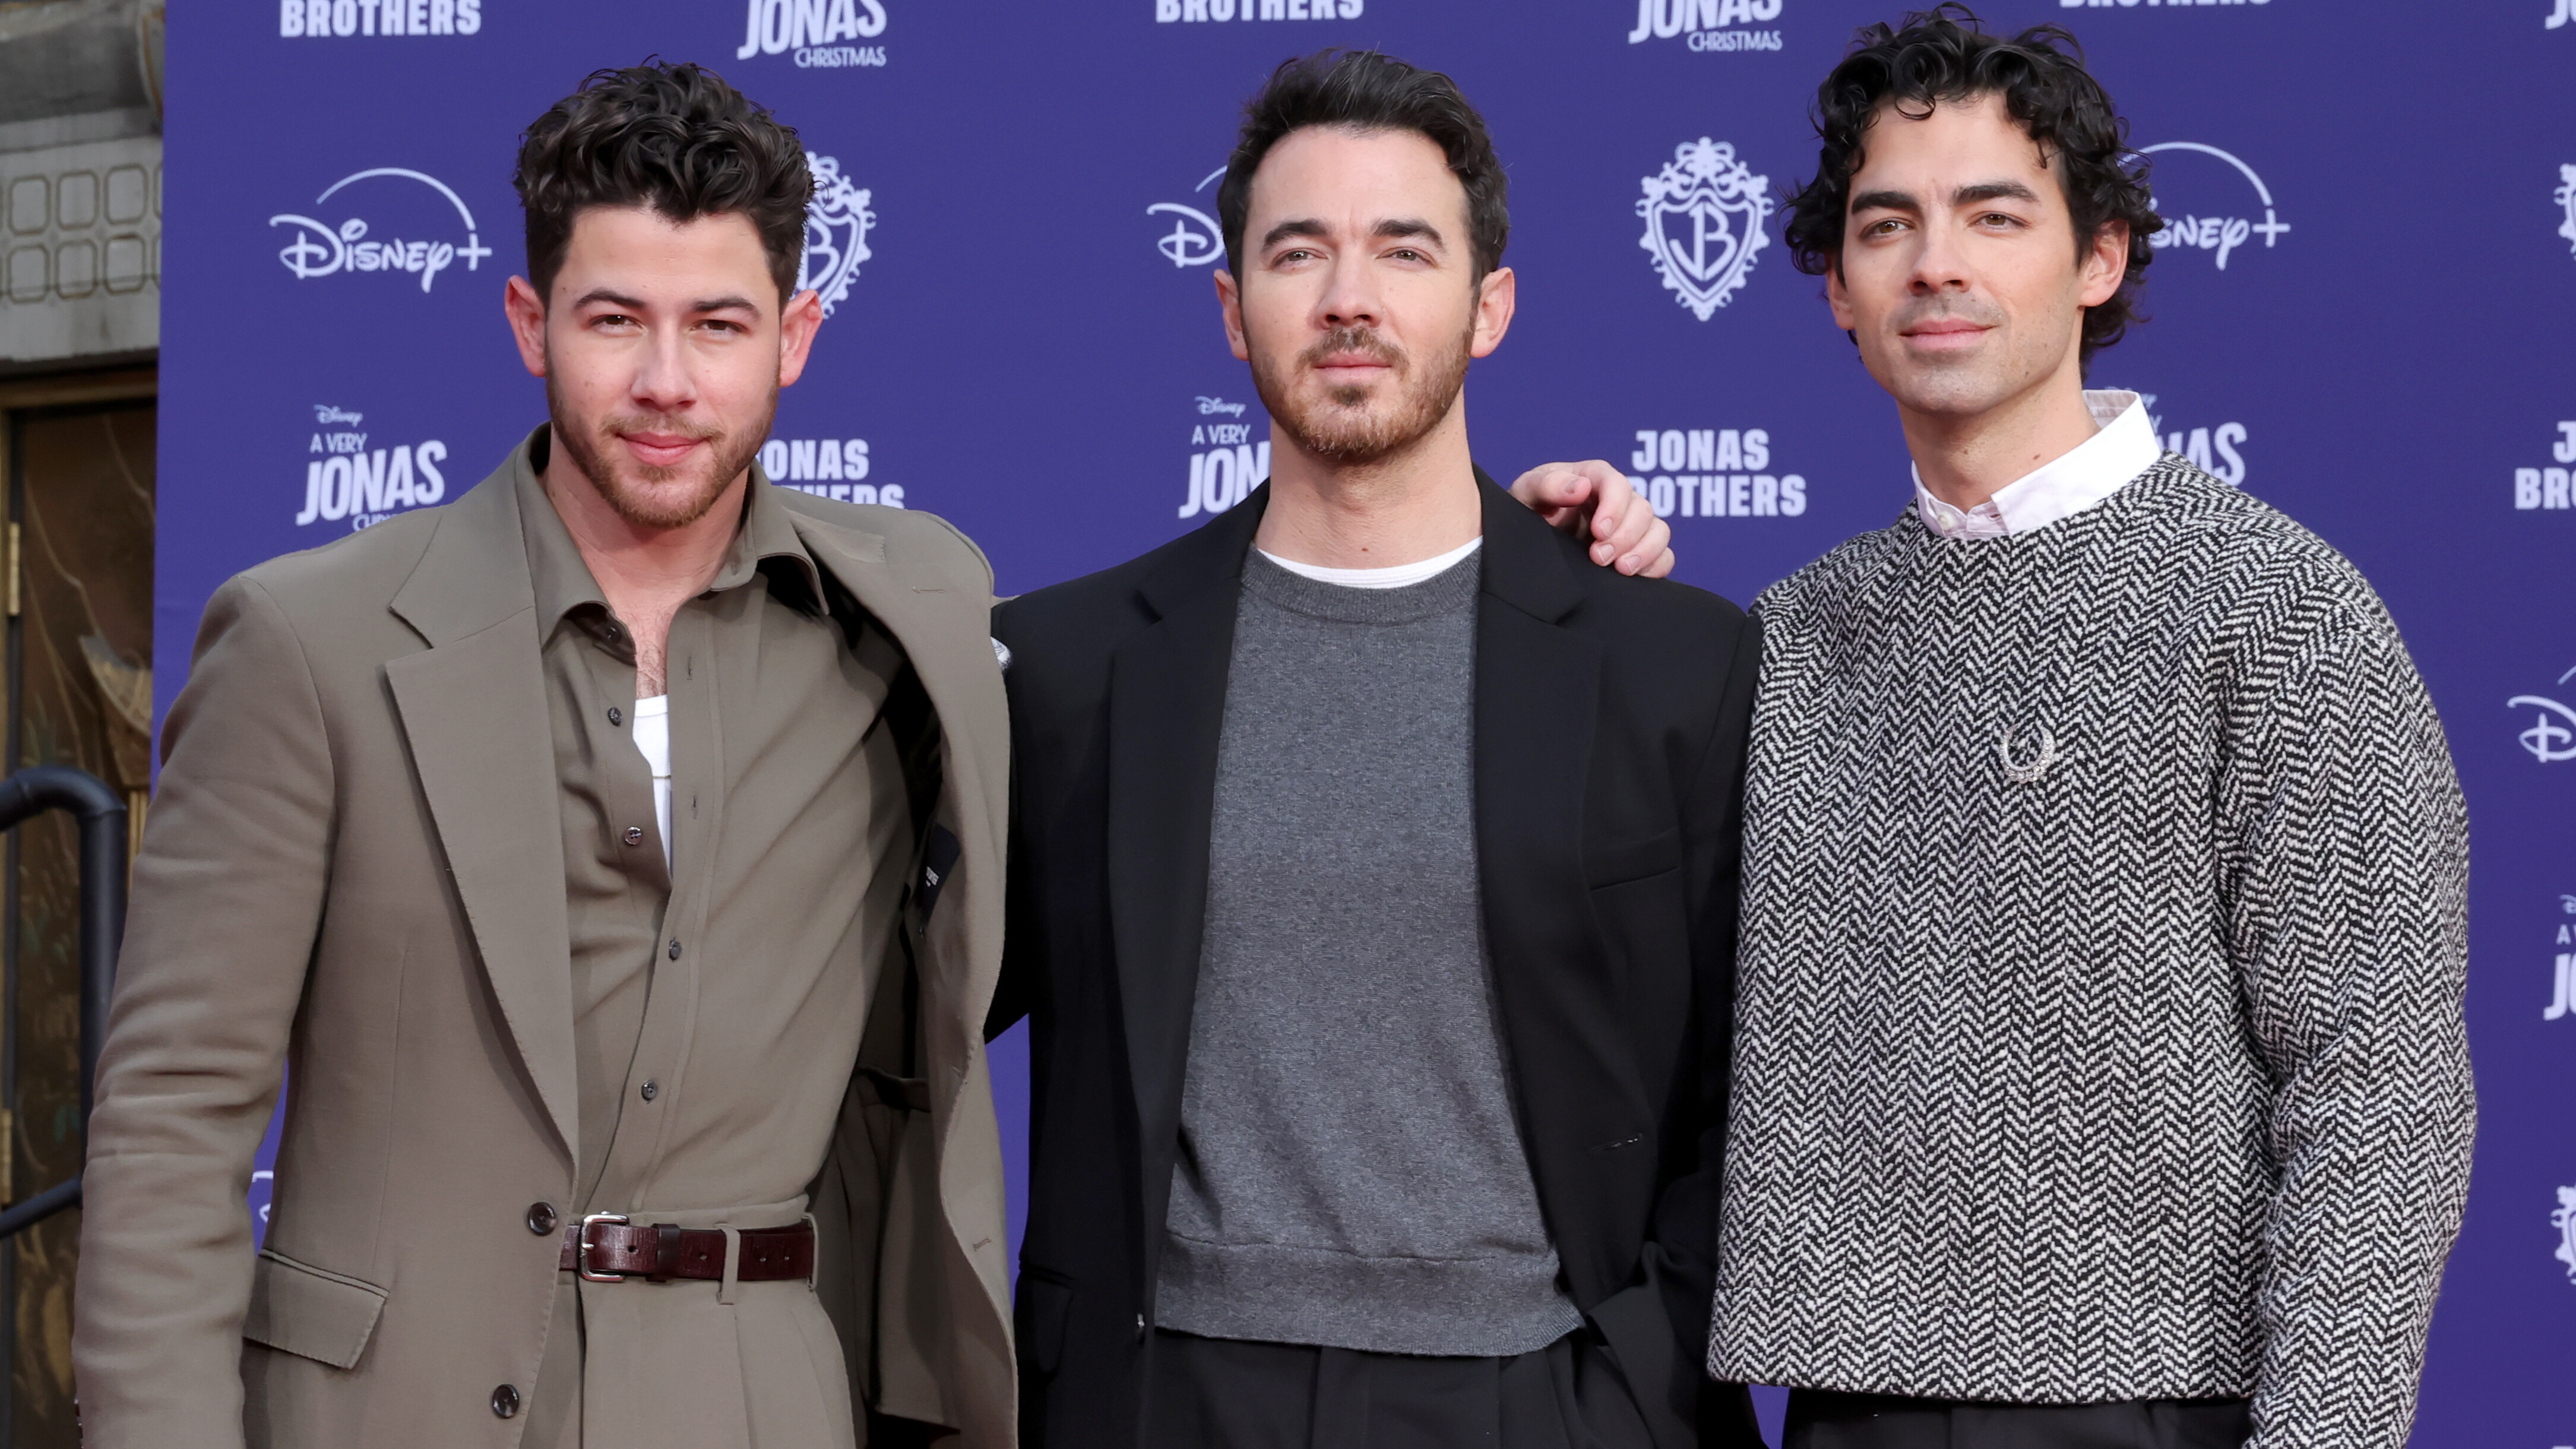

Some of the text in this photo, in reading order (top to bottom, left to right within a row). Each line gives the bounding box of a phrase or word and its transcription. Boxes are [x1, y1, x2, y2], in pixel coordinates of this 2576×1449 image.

[280, 0, 482, 37] BROTHERS
[737, 0, 887, 60] JONAS
[794, 46, 887, 68] CHRISTMAS
[1687, 30, 1783, 52] CHRISTMAS
[314, 404, 363, 428] Disney
[1194, 396, 1246, 419] Disney
[309, 432, 368, 454] A VERY
[1191, 423, 1251, 445] A VERY
[1631, 428, 1770, 472] JONAS
[755, 438, 870, 482] ONAS
[295, 439, 448, 526] JONAS
[1178, 440, 1271, 519] JON
[1626, 473, 1808, 518] OTHERS
